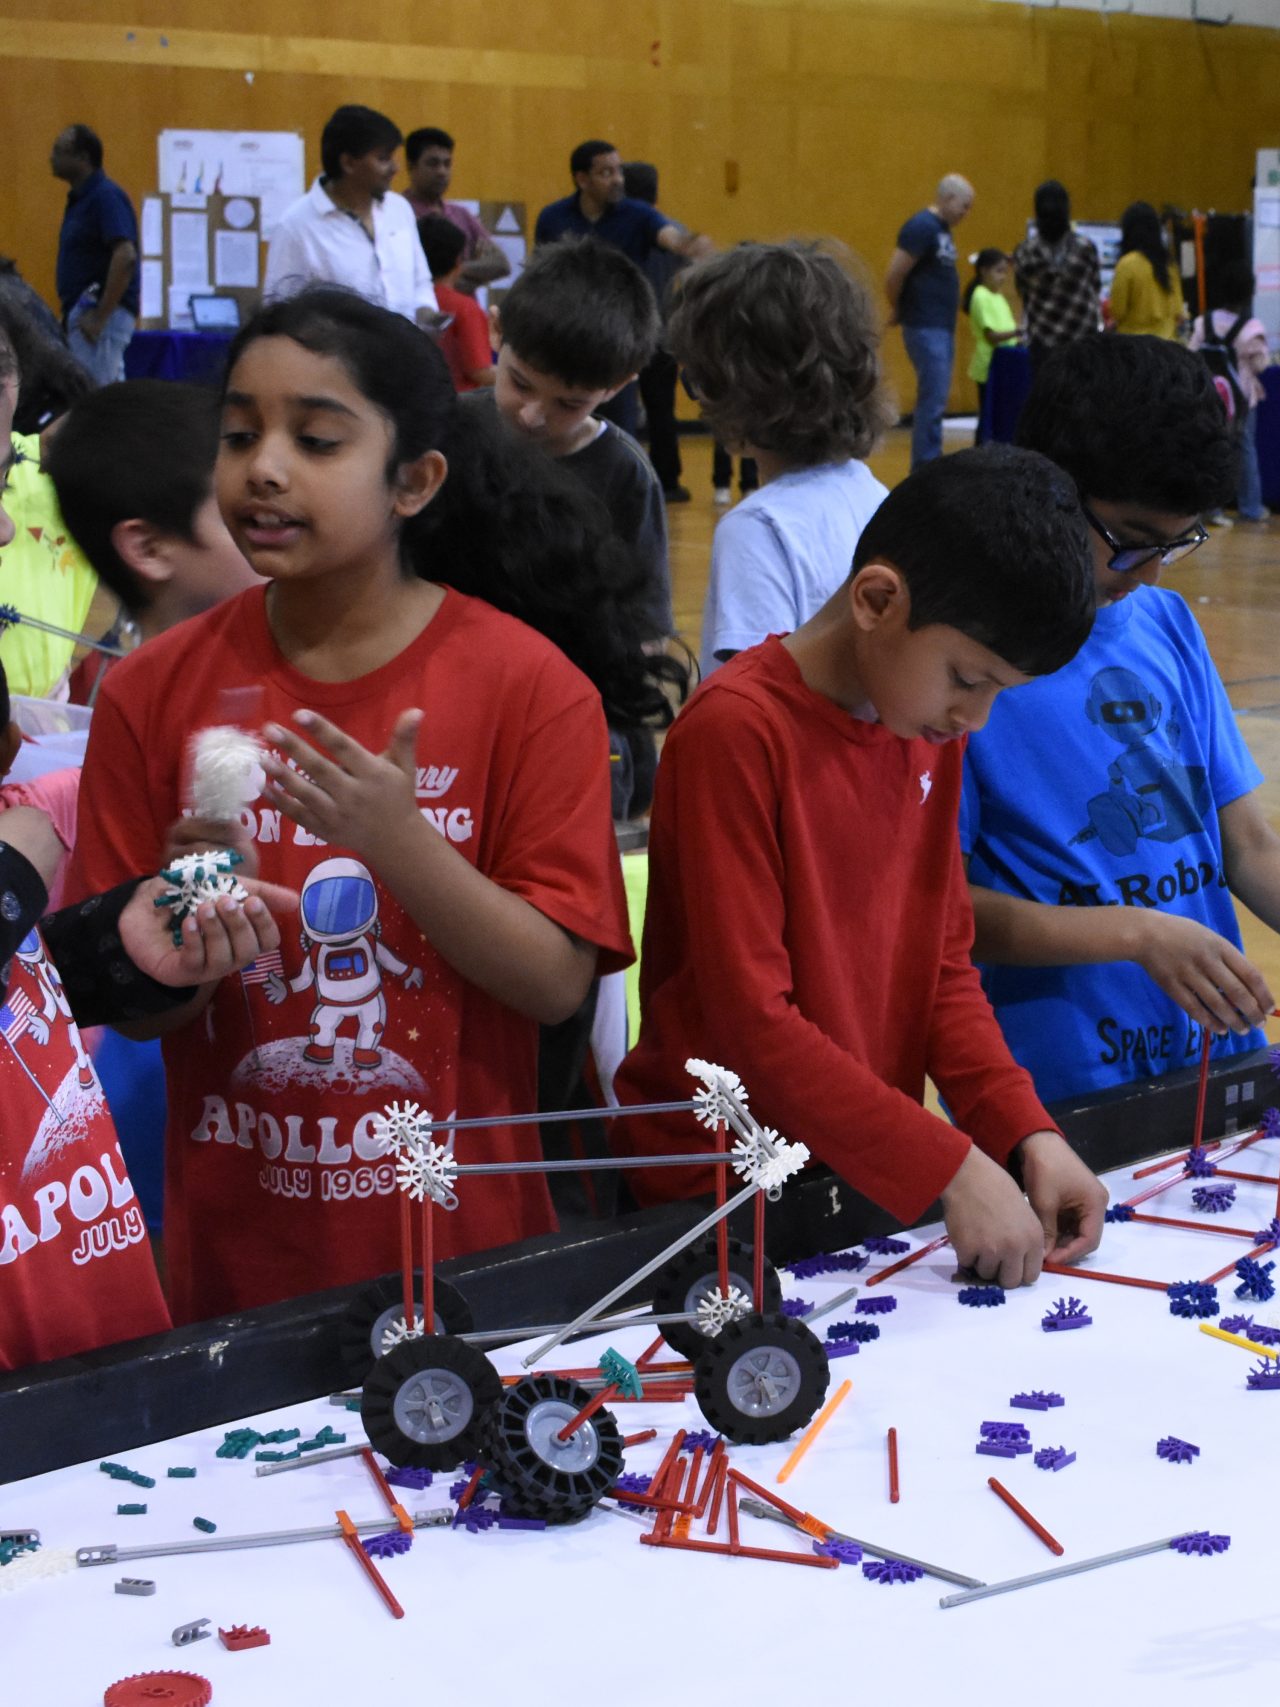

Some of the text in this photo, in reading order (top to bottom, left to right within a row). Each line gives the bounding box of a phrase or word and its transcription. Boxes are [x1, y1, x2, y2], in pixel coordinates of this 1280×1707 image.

[0, 1141, 135, 1265] APOL
[259, 1164, 398, 1201] JULY 1969
[72, 1206, 145, 1266] JULY
